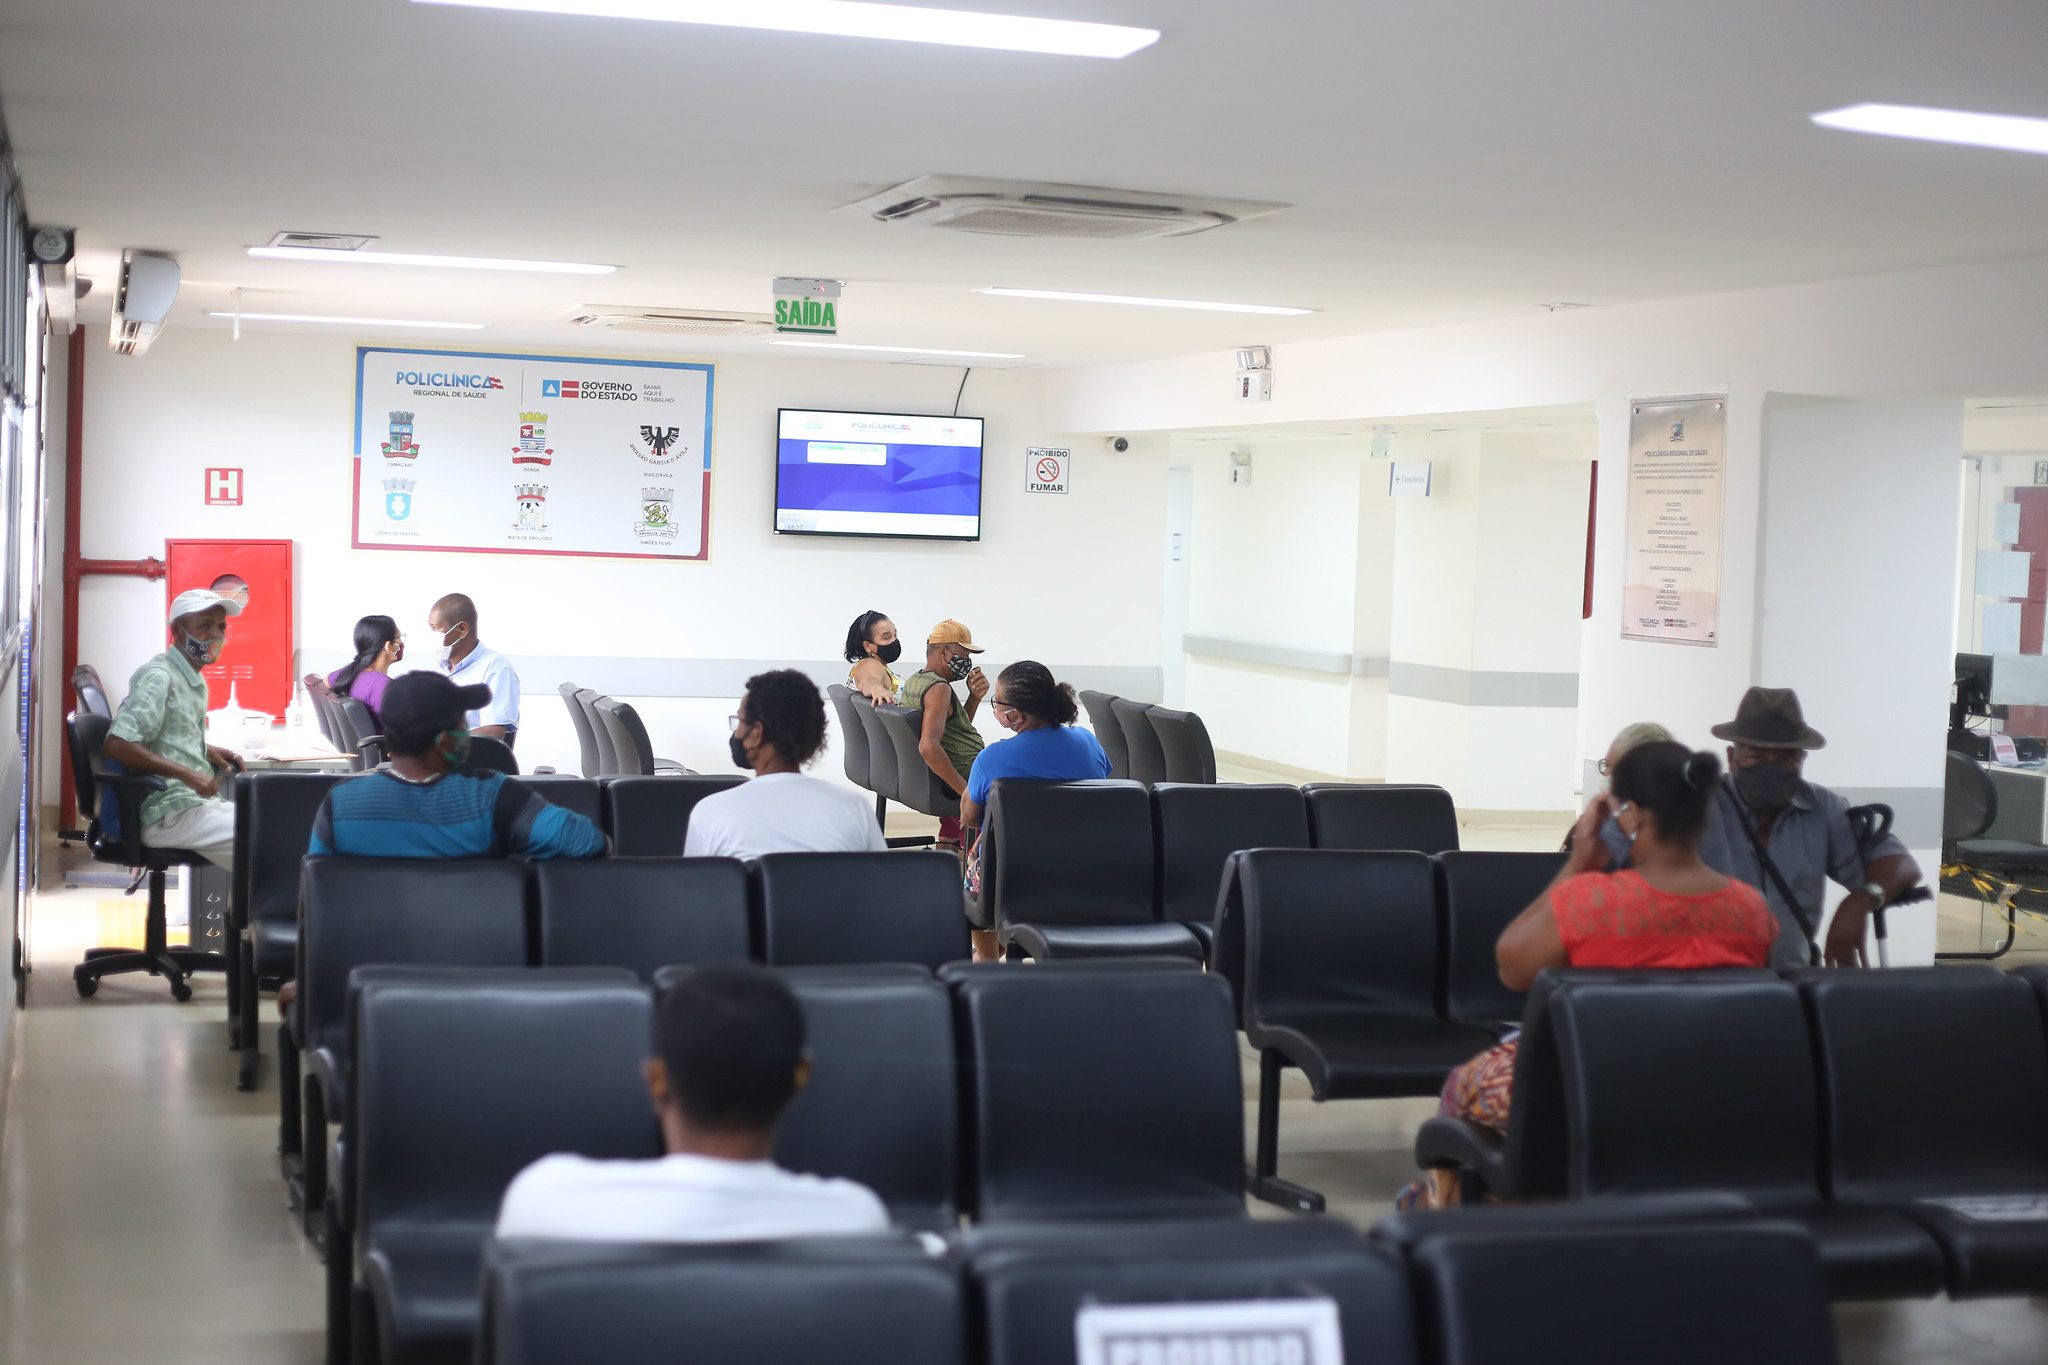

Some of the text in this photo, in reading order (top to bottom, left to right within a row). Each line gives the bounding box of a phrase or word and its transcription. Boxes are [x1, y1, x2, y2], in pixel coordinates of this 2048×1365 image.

[776, 296, 836, 327] SAÍDA
[396, 371, 496, 389] POLICLÍNICA
[581, 381, 633, 392] GOVERNO
[413, 389, 450, 397] REGIONAL
[463, 390, 487, 399] SAÚDE
[581, 391, 638, 401] DO ESTADO
[1029, 449, 1068, 457] PROIBIDO
[210, 470, 238, 499] H
[1030, 483, 1064, 492] FUMAR
